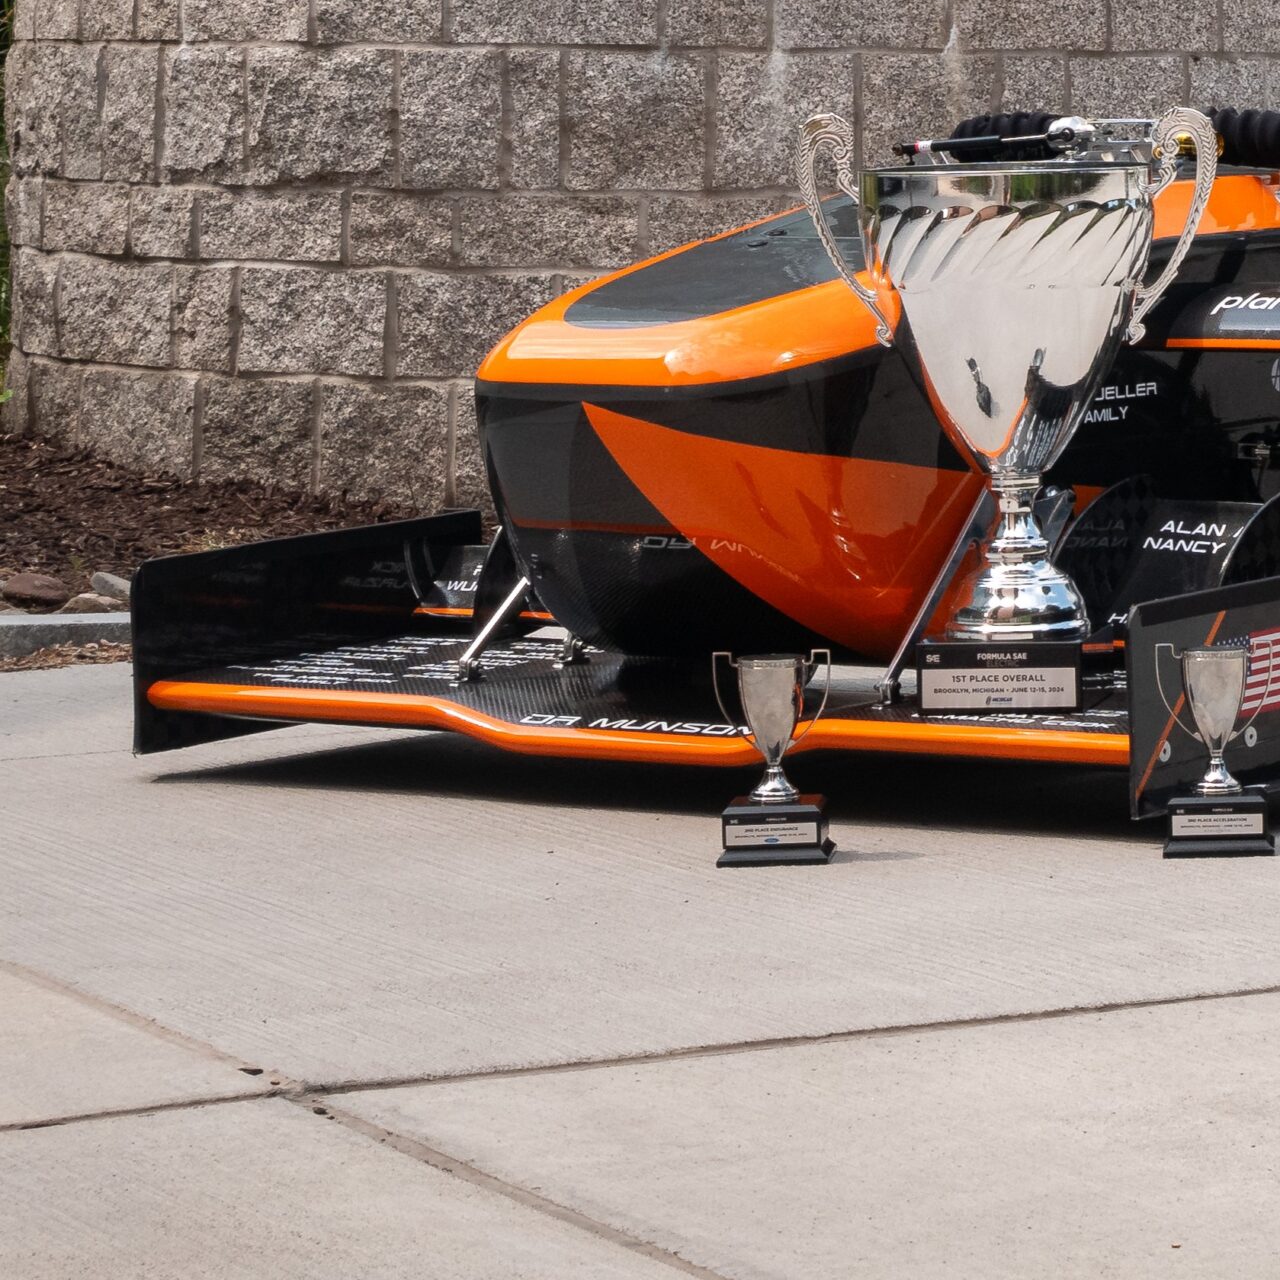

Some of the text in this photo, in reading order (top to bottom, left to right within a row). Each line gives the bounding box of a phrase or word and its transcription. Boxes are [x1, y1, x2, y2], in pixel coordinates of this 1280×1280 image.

[1084, 406, 1129, 424] AMILY
[1160, 520, 1226, 537] ALAN
[1143, 537, 1226, 554] NANCY
[977, 653, 1011, 661] FORMULA
[952, 674, 1046, 683] 1ST PLACE OVERALL
[933, 687, 970, 695] BROOKLYN,
[520, 713, 752, 735] DR MUNSON
[1042, 720, 1116, 729] COOK
